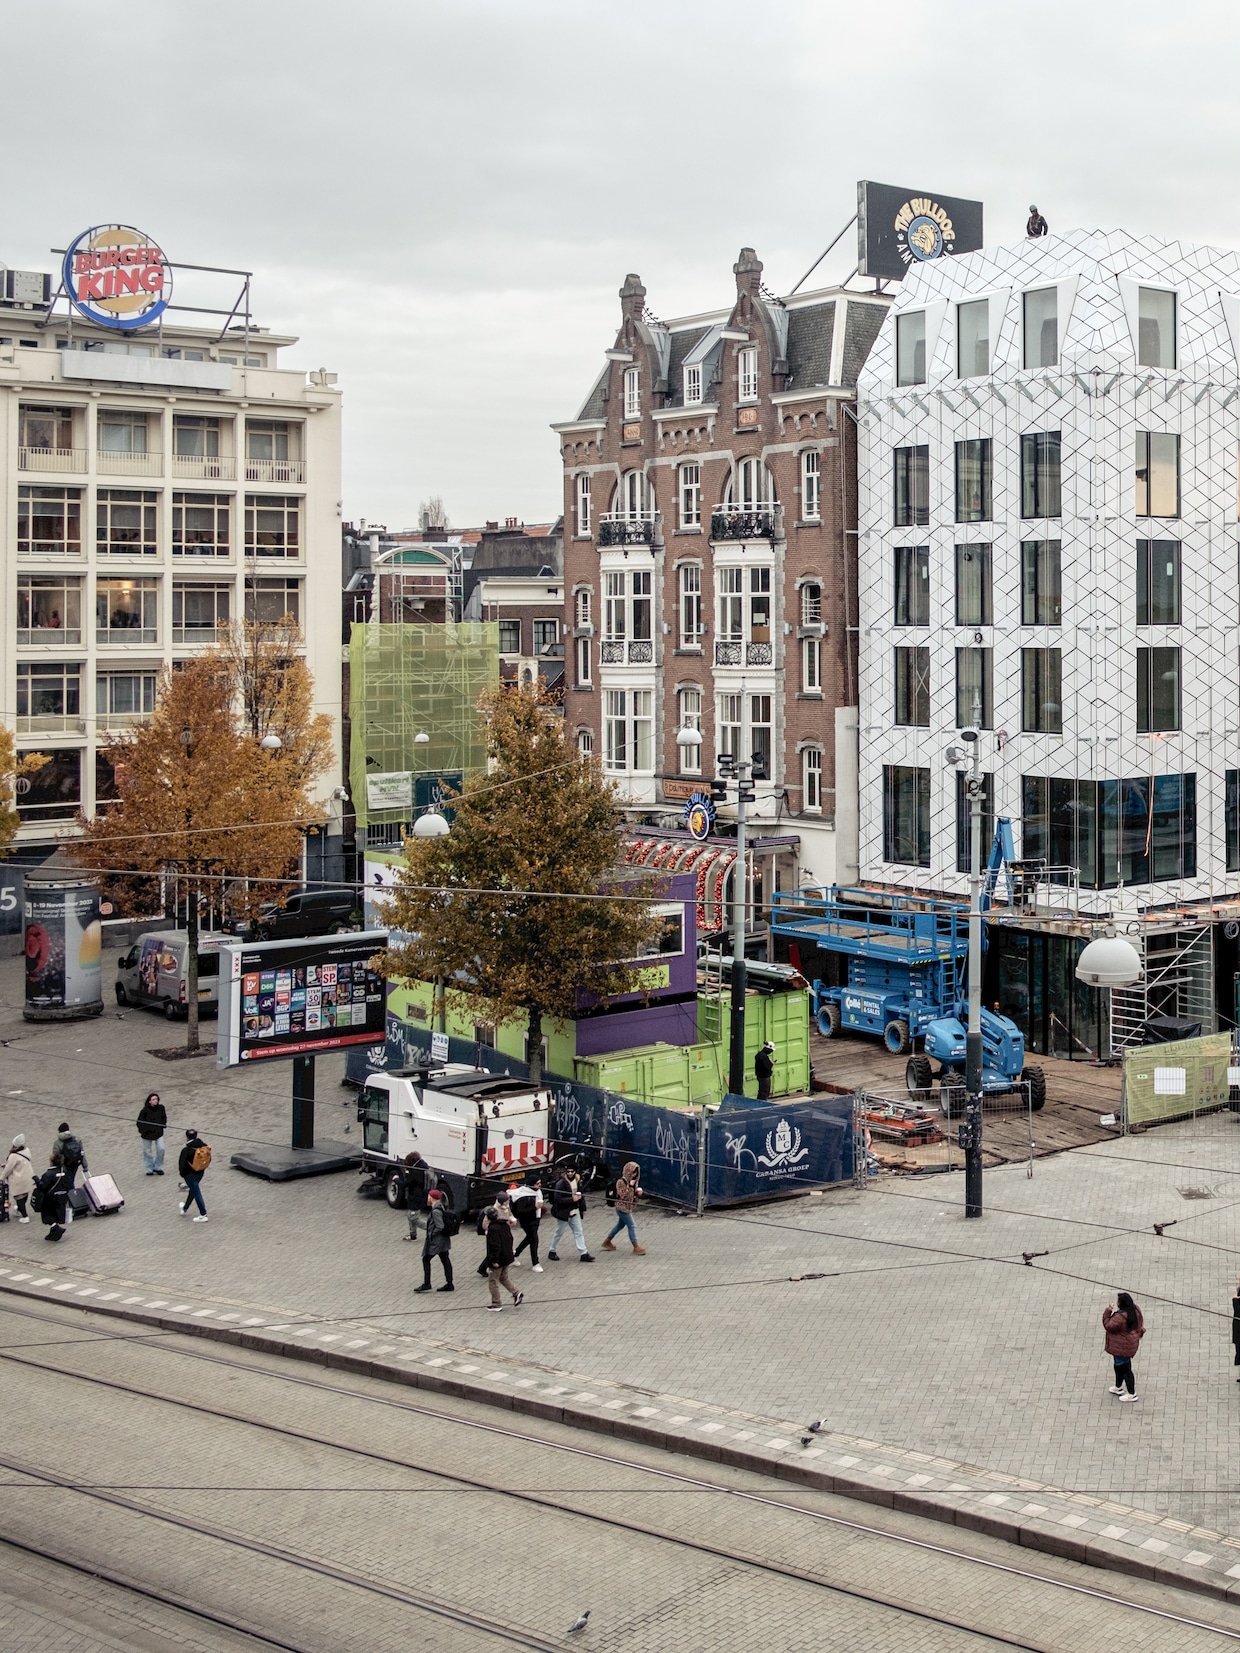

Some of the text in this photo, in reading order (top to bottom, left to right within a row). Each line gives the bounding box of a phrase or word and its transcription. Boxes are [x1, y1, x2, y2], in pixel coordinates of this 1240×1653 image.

[894, 198, 956, 240] THE BULLDOG
[76, 248, 162, 274] BURGER
[78, 266, 164, 301] KING
[0, 886, 17, 911] 5
[309, 994, 319, 1002] 50
[863, 1000, 880, 1009] RENTAL
[244, 1007, 259, 1015] Volt
[867, 1007, 880, 1016] SALES
[788, 1164, 810, 1173] GROEP
